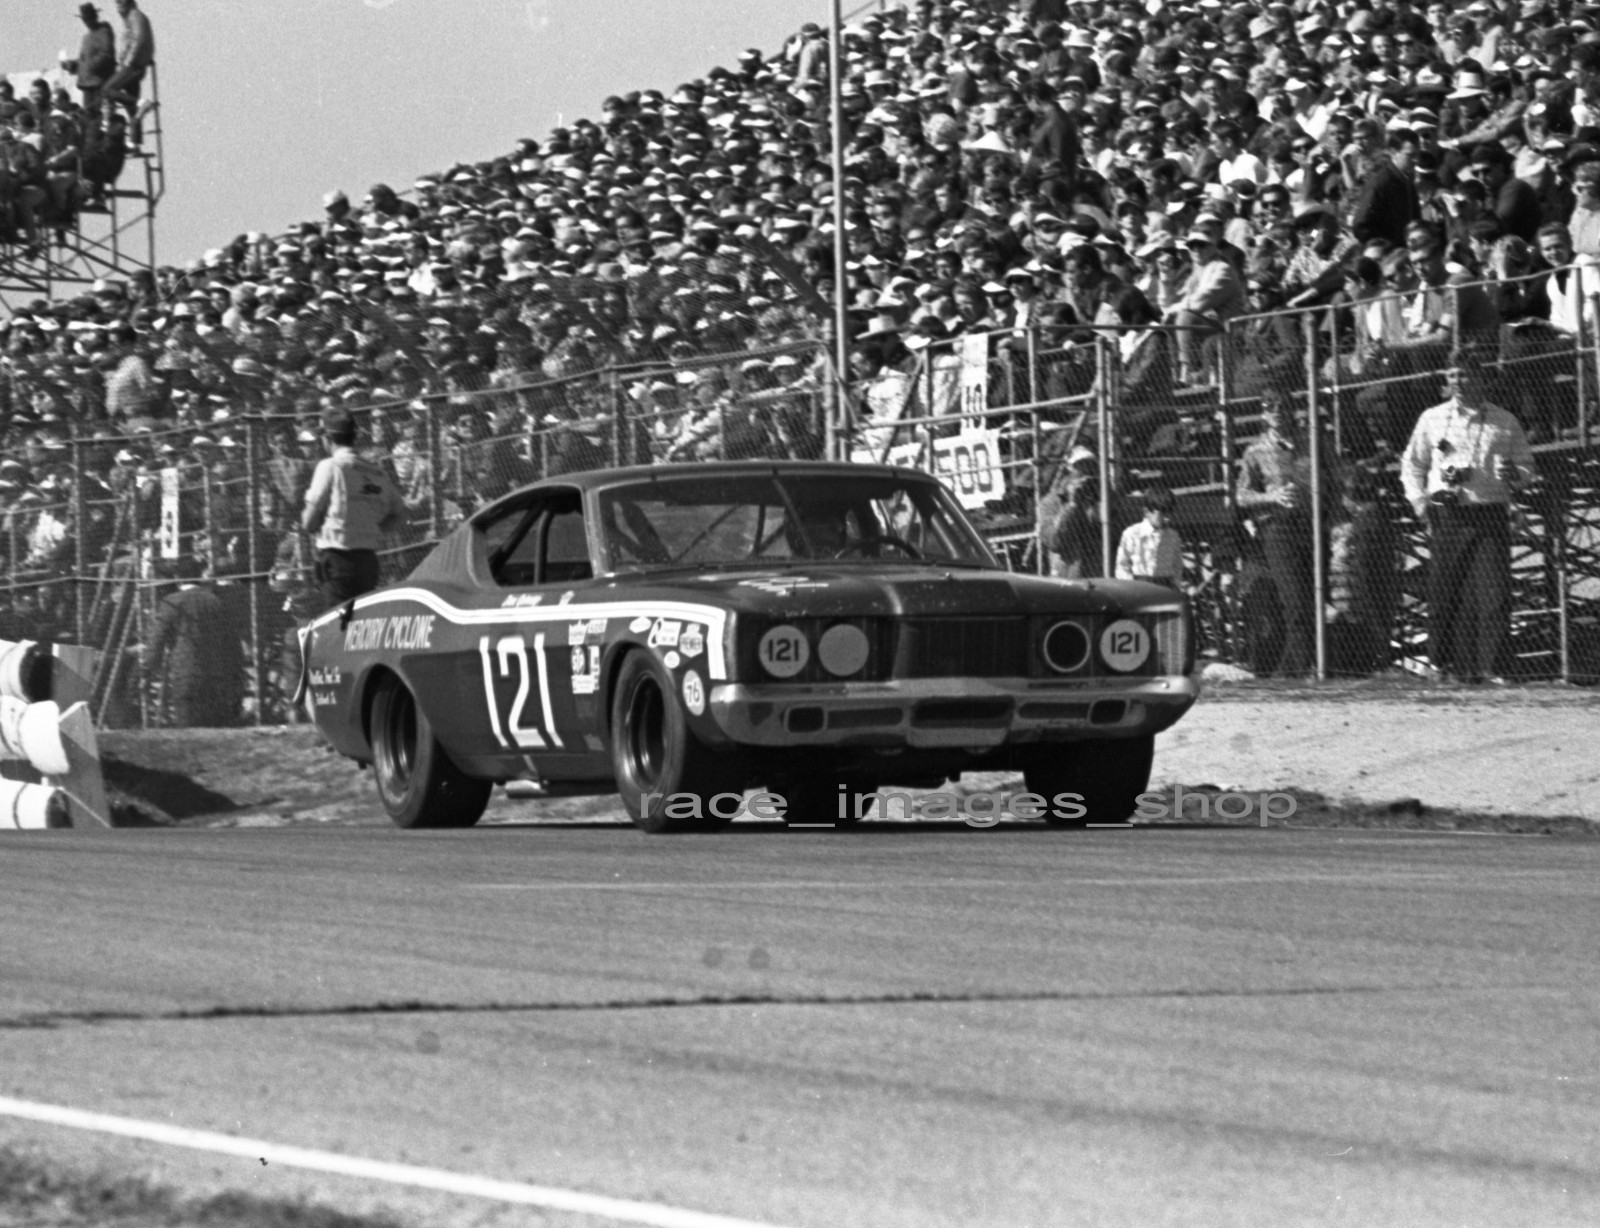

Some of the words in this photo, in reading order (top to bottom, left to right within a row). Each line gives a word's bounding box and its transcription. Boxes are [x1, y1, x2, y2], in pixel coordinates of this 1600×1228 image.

[934, 442, 993, 495] 500
[343, 617, 388, 652] MERCURY
[384, 615, 436, 649] CYCLONE
[1110, 632, 1140, 655] 121
[768, 638, 800, 662] 121
[479, 632, 565, 749] 121
[686, 681, 700, 703] 76
